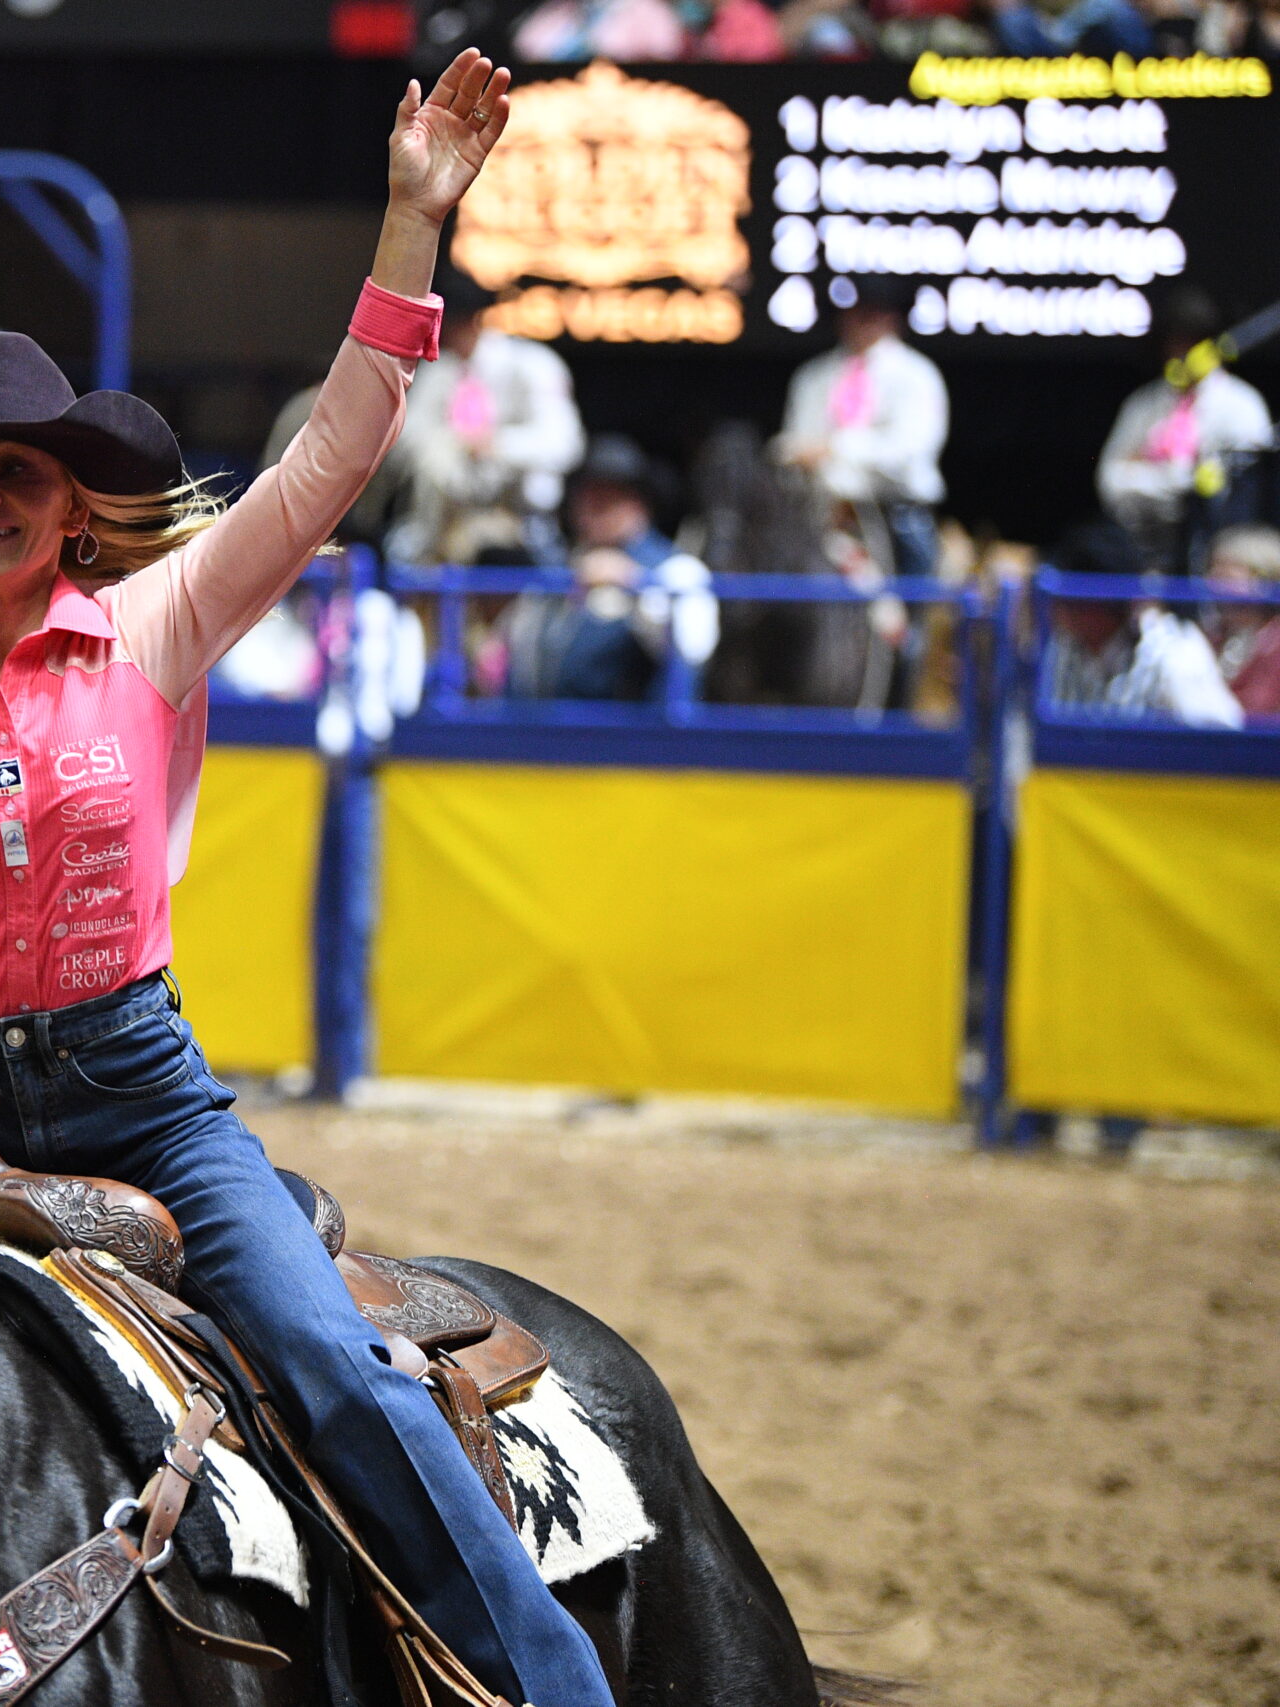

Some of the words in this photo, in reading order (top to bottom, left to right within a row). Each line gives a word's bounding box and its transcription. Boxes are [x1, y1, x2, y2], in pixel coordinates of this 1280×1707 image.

[782, 98, 816, 150] 1
[49, 740, 87, 756] ELITE
[89, 733, 120, 746] TEAM
[54, 743, 127, 781] CSI
[60, 773, 130, 795] SADDLEPADS
[63, 858, 129, 877] SADDLERY
[70, 914, 130, 933] ICONOCLAST
[59, 966, 126, 990] CROWN
